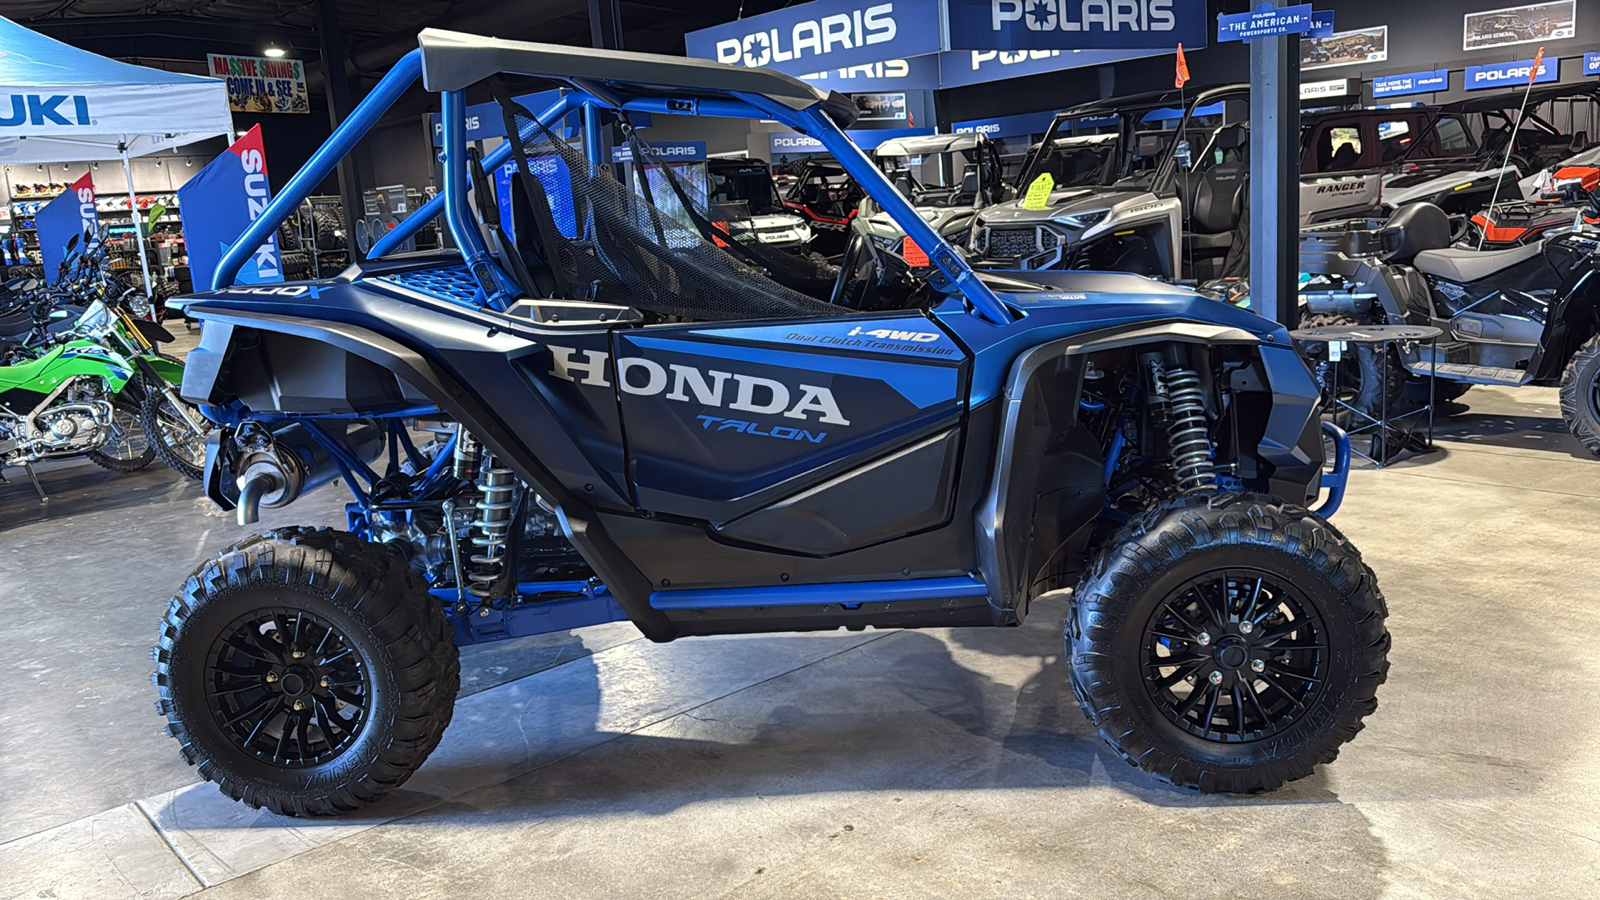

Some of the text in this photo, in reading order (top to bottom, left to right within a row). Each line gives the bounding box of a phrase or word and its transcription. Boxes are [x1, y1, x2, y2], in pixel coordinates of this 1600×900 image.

[992, 0, 1176, 31] POLARIS
[1229, 15, 1300, 31] THE AMERICAN
[716, 3, 897, 67] POLARIS
[1240, 28, 1277, 37] POWERSPORTS
[226, 77, 254, 95] COME
[255, 79, 265, 95] IN
[267, 82, 275, 97] &
[275, 80, 293, 97] SEE
[1317, 181, 1366, 194] RANGER
[809, 220, 847, 232] RZR
[785, 332, 955, 355] Dual Clutch Transmission
[547, 344, 851, 427] HONDA
[696, 414, 828, 444] TALON
